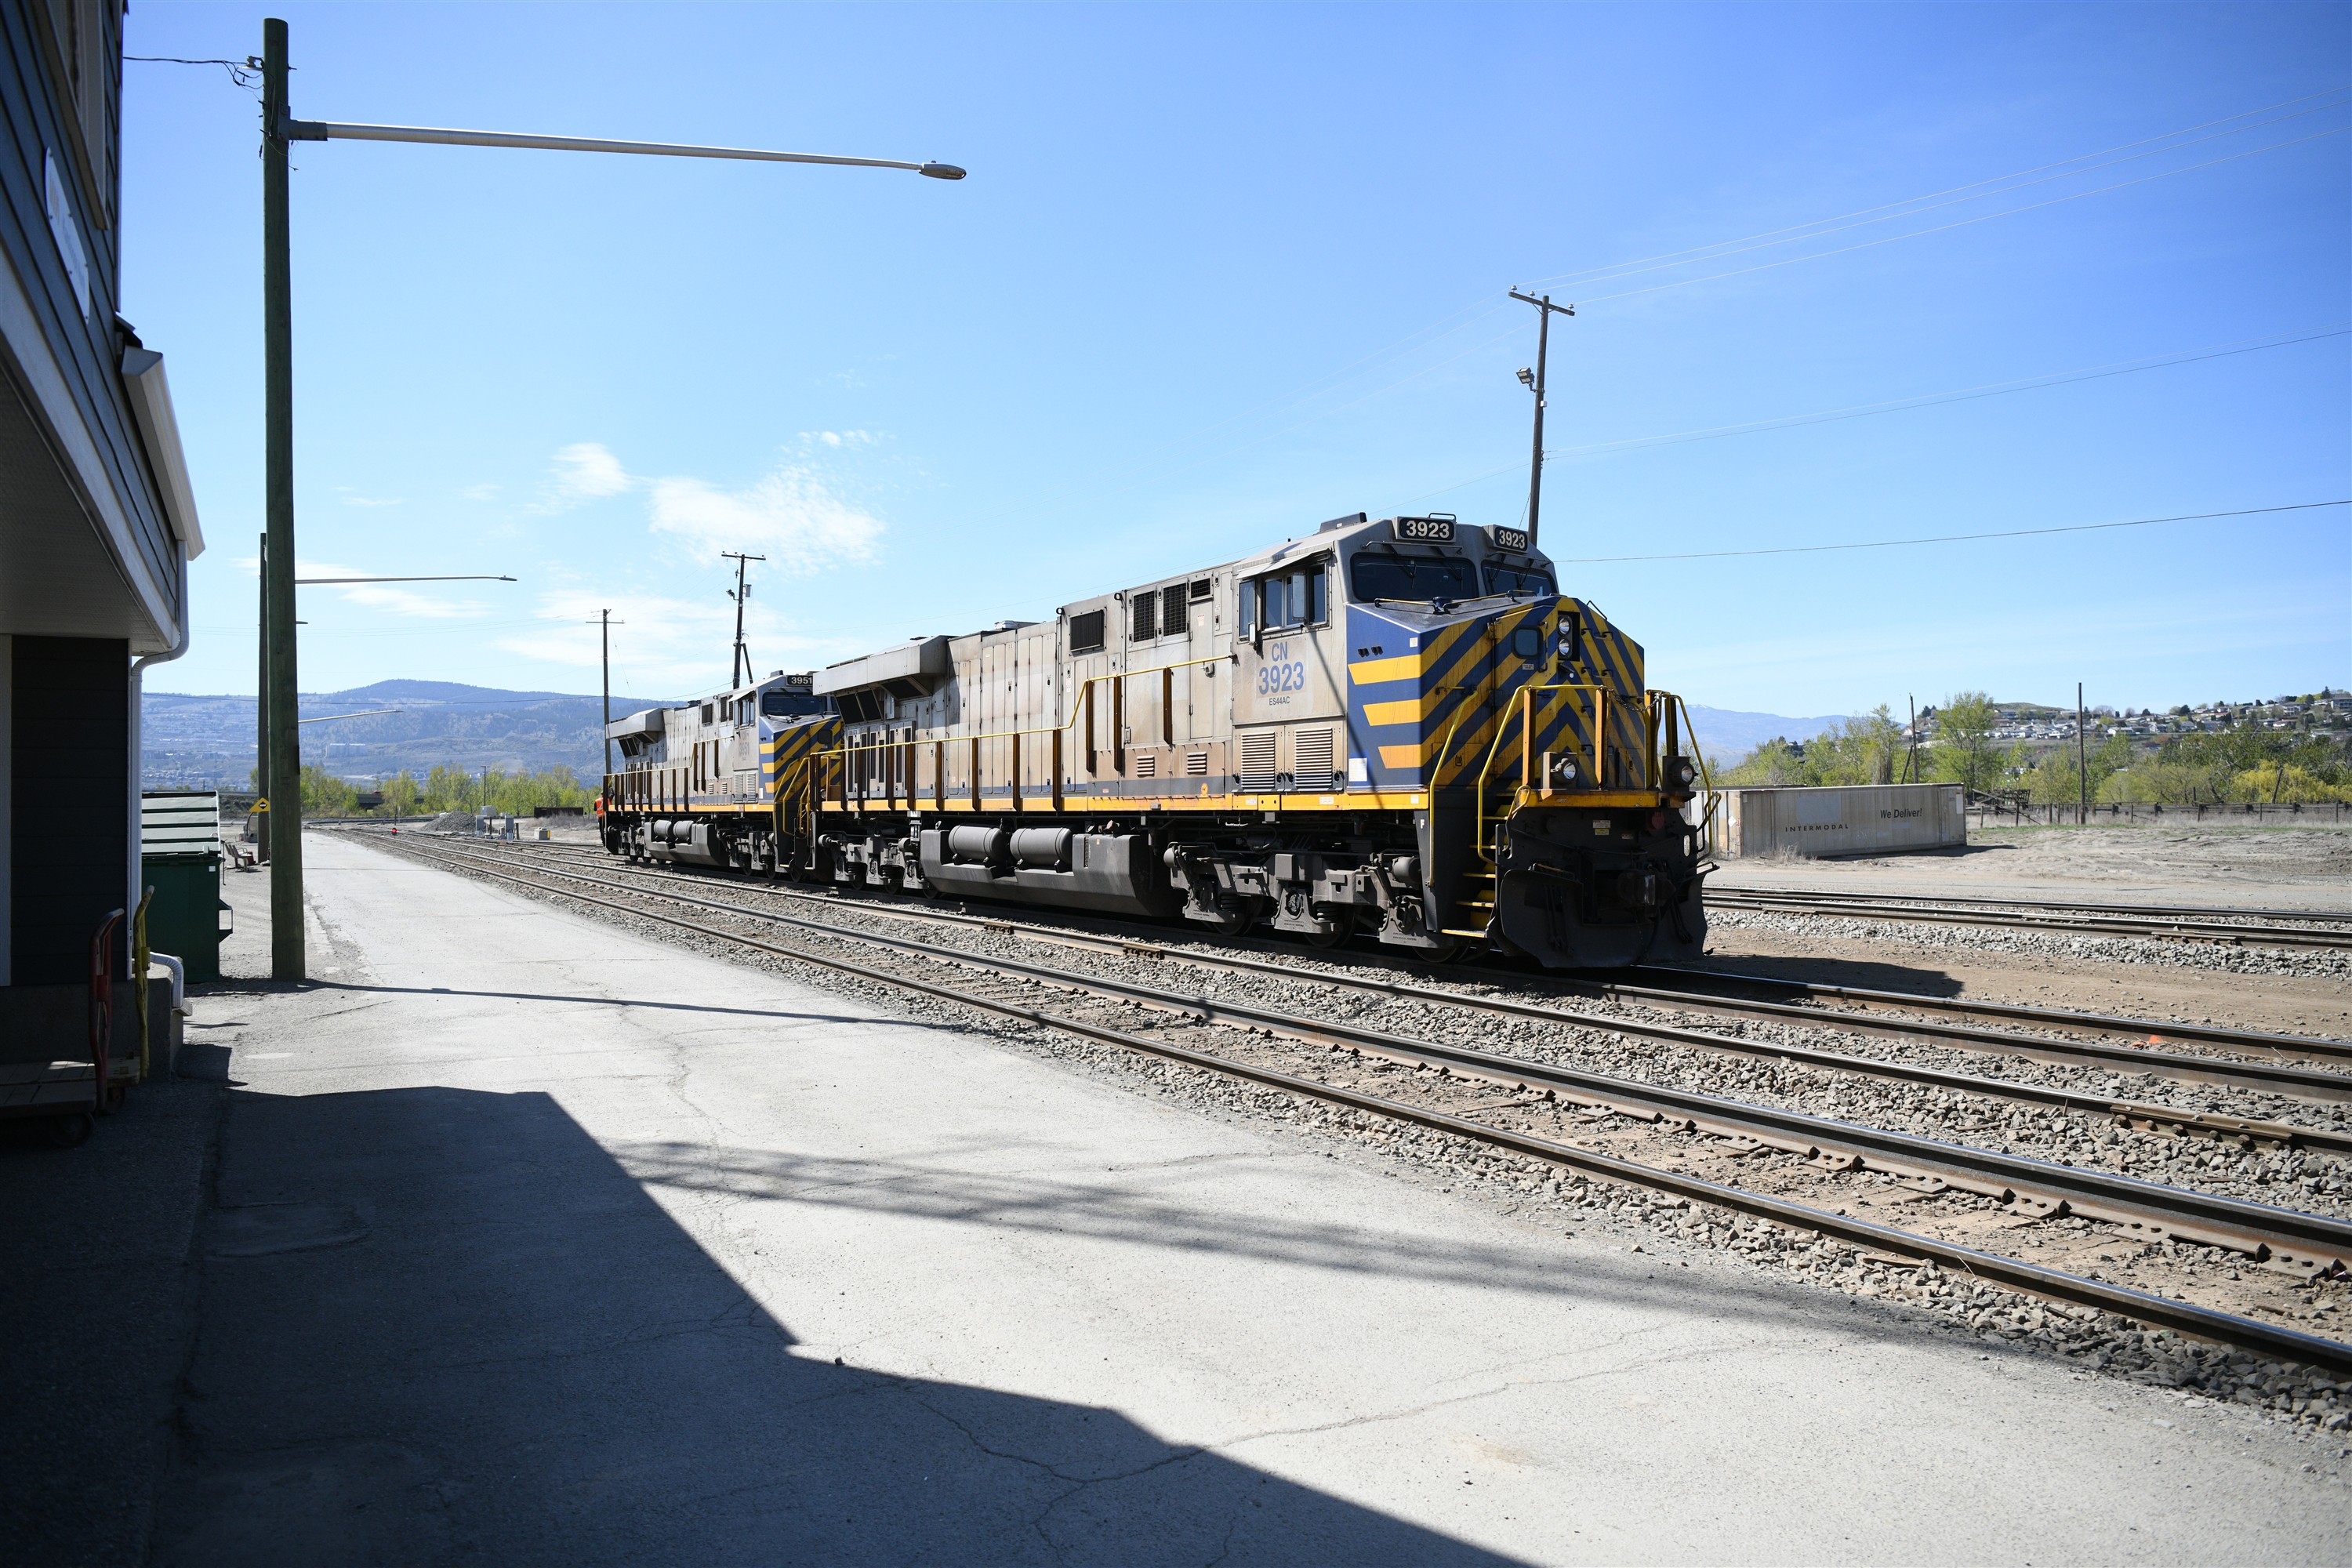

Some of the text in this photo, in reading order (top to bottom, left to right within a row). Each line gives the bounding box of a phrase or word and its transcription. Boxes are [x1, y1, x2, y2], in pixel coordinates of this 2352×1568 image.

[1406, 521, 1450, 539] 3923
[1499, 529, 1526, 549] 3923
[1272, 642, 1288, 662] CN
[1258, 662, 1305, 695] 3923
[1269, 696, 1290, 706] ES44AC
[1880, 808, 1922, 818] We Deliver!
[1785, 823, 1849, 832] INTERMODAL
